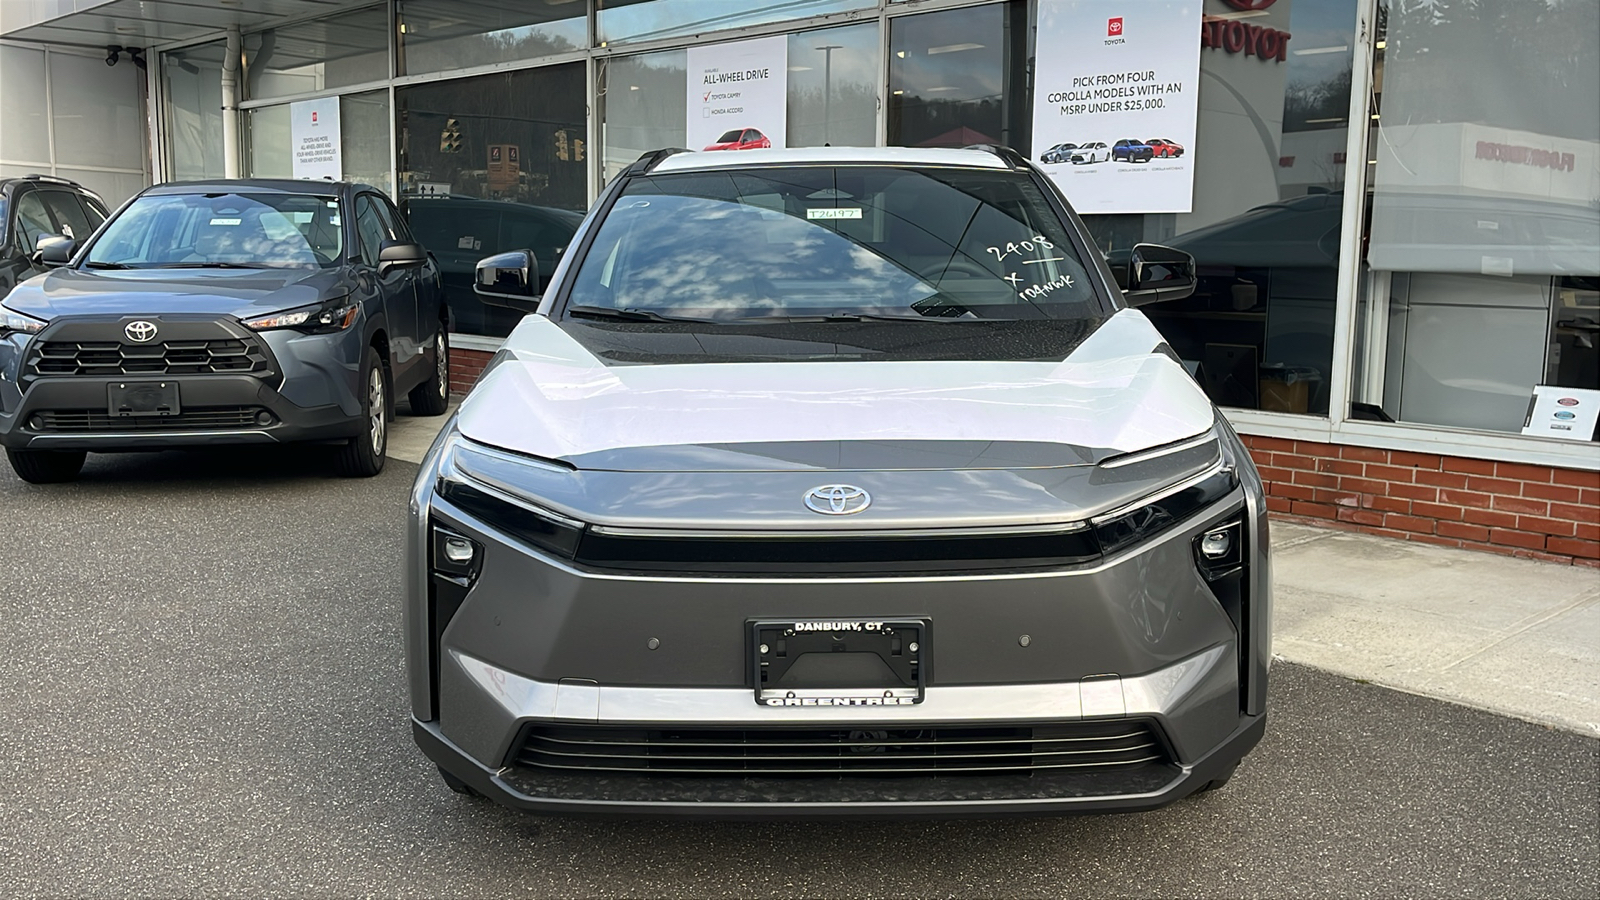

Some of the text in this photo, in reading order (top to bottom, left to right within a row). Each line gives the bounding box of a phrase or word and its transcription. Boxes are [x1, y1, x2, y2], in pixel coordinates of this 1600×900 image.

[1104, 38, 1125, 46] TOYOTA
[703, 68, 769, 84] ALL-WHEEL DRIVE
[1072, 70, 1155, 88] PICK FROM FOUR
[1047, 82, 1182, 103] COROLLA MODELS WITH AN
[1060, 98, 1166, 116] MSRP UNDER $25,000.
[986, 235, 1054, 262] 2408
[795, 622, 884, 632] DANBURY, CT
[766, 697, 914, 706] GREENTREE
